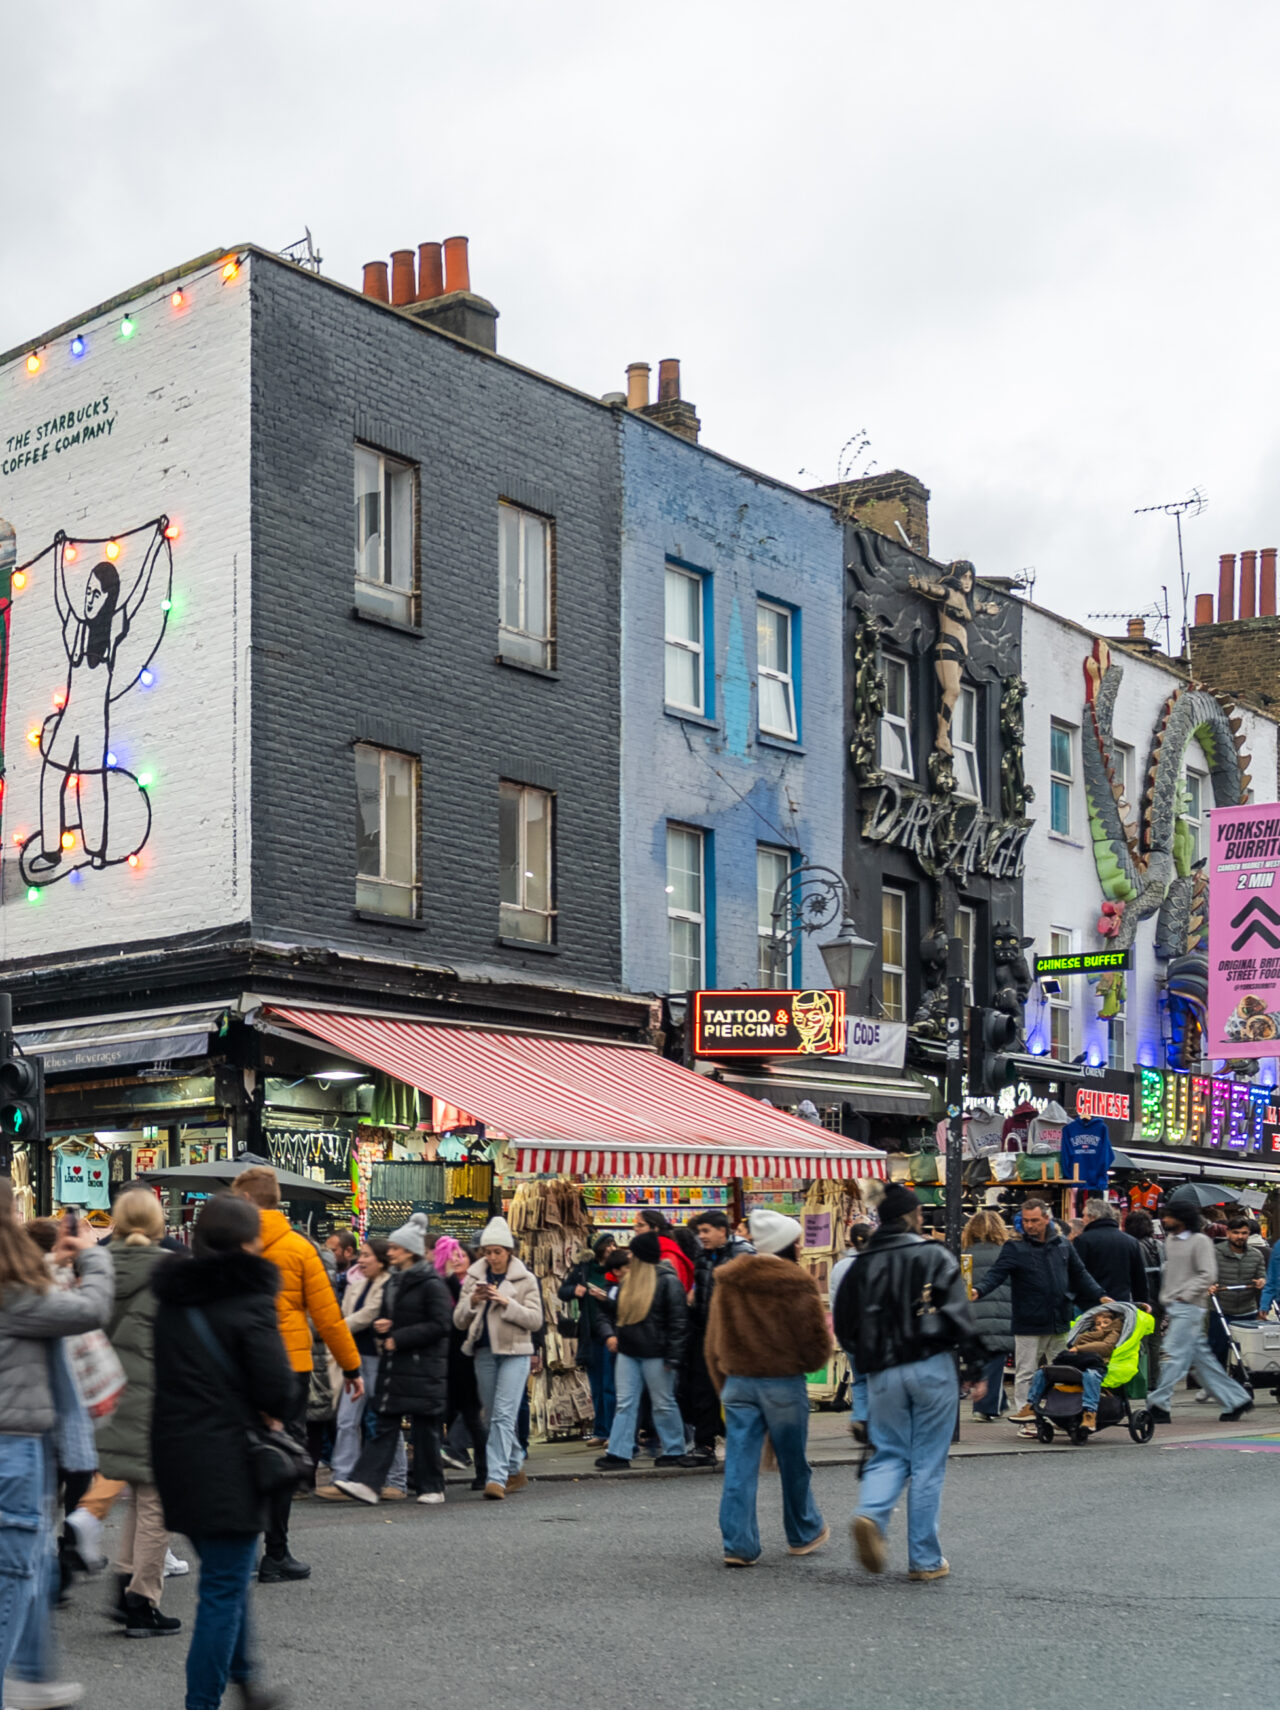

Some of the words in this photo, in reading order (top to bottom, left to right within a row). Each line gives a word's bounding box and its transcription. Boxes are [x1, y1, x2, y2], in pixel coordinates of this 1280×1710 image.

[6, 434, 30, 453] THE
[36, 397, 110, 440] STARBUCKS
[2, 448, 49, 476] COFFEE
[55, 418, 115, 452] COMPANY
[1217, 819, 1280, 842] YORKSHI
[1237, 873, 1248, 891] 2
[1248, 872, 1276, 889] MIN
[1036, 957, 1081, 972] CHINESE
[1083, 953, 1125, 969] BUFFET
[1218, 959, 1257, 971] ORIGINAL
[1226, 969, 1258, 981] STREET
[703, 1009, 771, 1024] TATTOO
[775, 1008, 790, 1024] &
[704, 1024, 787, 1038] PIERCING
[853, 1022, 880, 1046] CODE
[75, 1050, 122, 1068] Beverages
[1076, 1087, 1130, 1122] CHINESE
[1140, 1066, 1272, 1152] BUFFET
[1071, 1134, 1101, 1147] LONDON
[65, 1174, 84, 1184] LONDON
